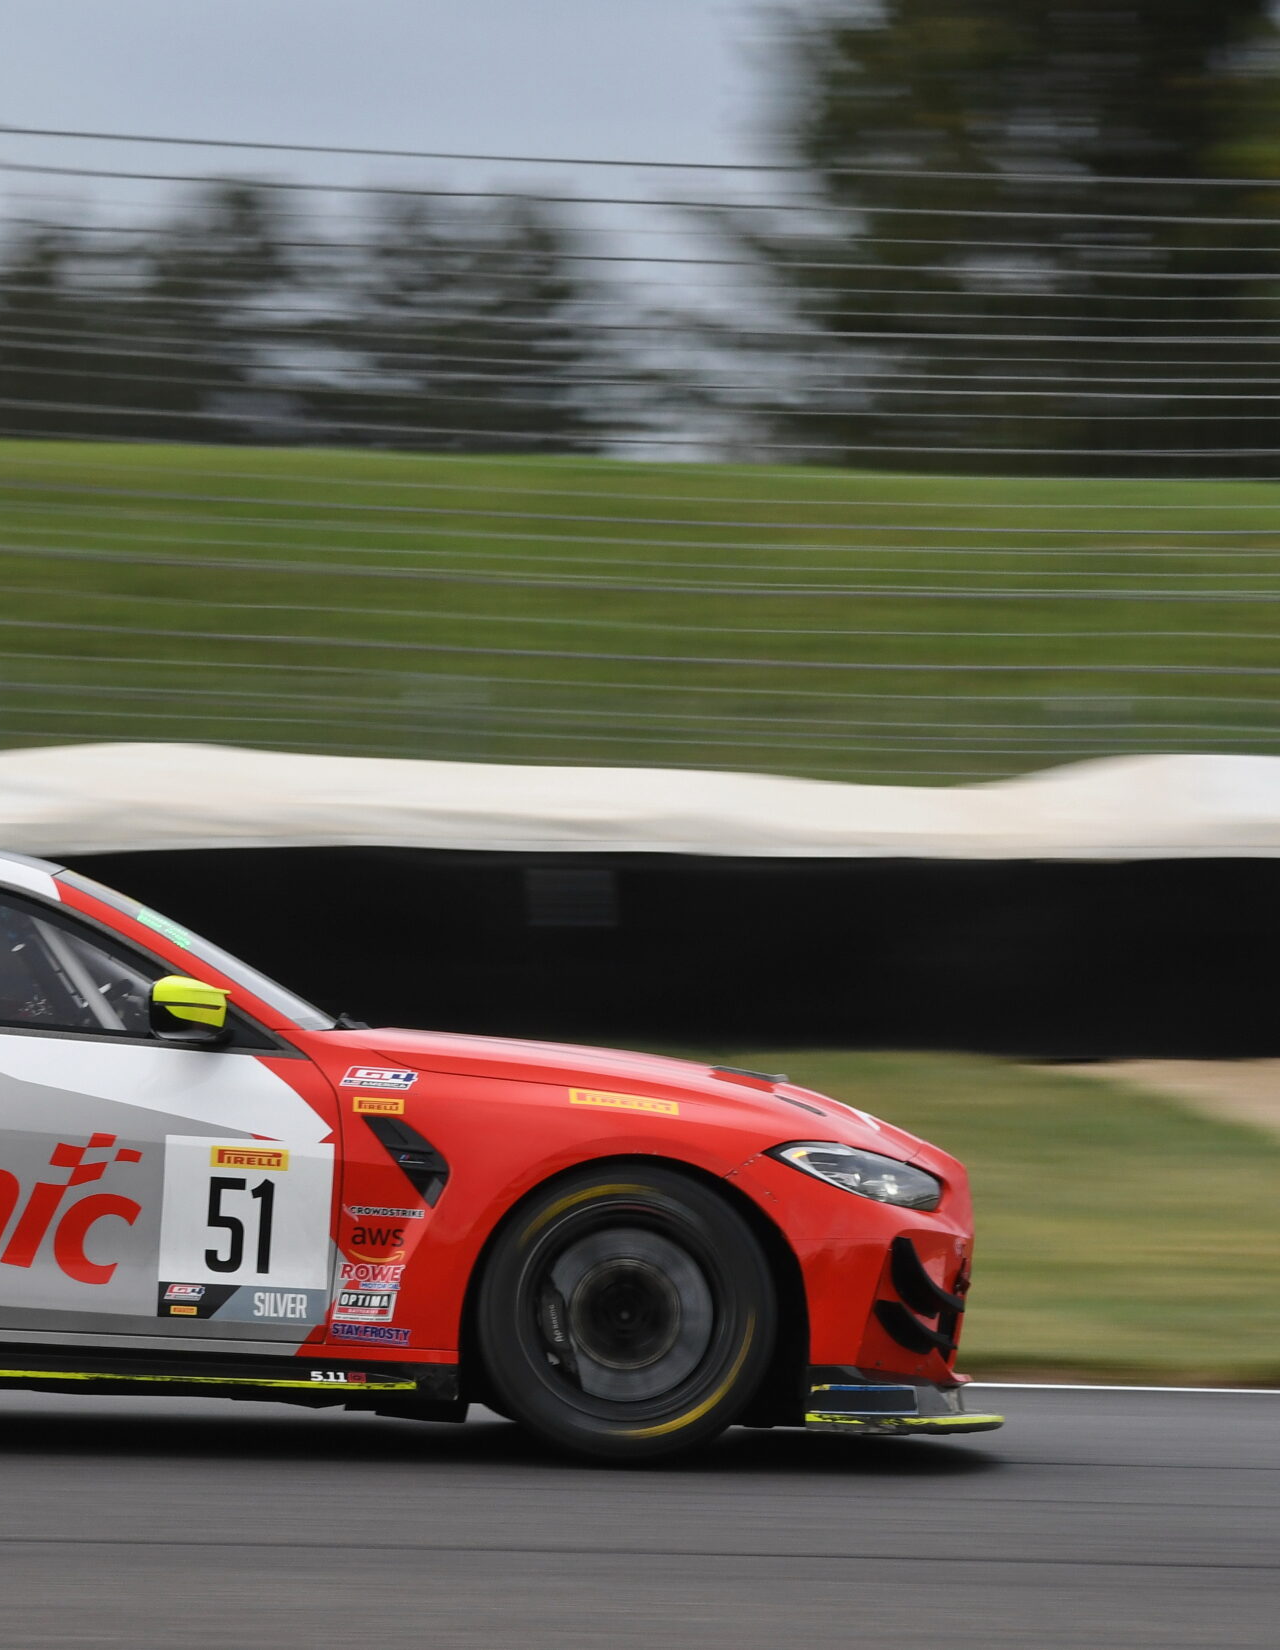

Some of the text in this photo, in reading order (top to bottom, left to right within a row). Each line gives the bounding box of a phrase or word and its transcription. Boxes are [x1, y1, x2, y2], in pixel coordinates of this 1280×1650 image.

[358, 1100, 400, 1111] PIRELLI
[217, 1149, 283, 1167] PIRELLI
[350, 1207, 424, 1219] CROWDSTRIKE
[205, 1176, 275, 1274] 51
[351, 1227, 404, 1247] aws
[340, 1263, 405, 1282] ROWE
[253, 1292, 307, 1319] SILVER
[340, 1293, 389, 1308] OPTIMA
[332, 1323, 361, 1336] STAY
[363, 1326, 410, 1341] FROSTY
[310, 1371, 347, 1382] 5.11
